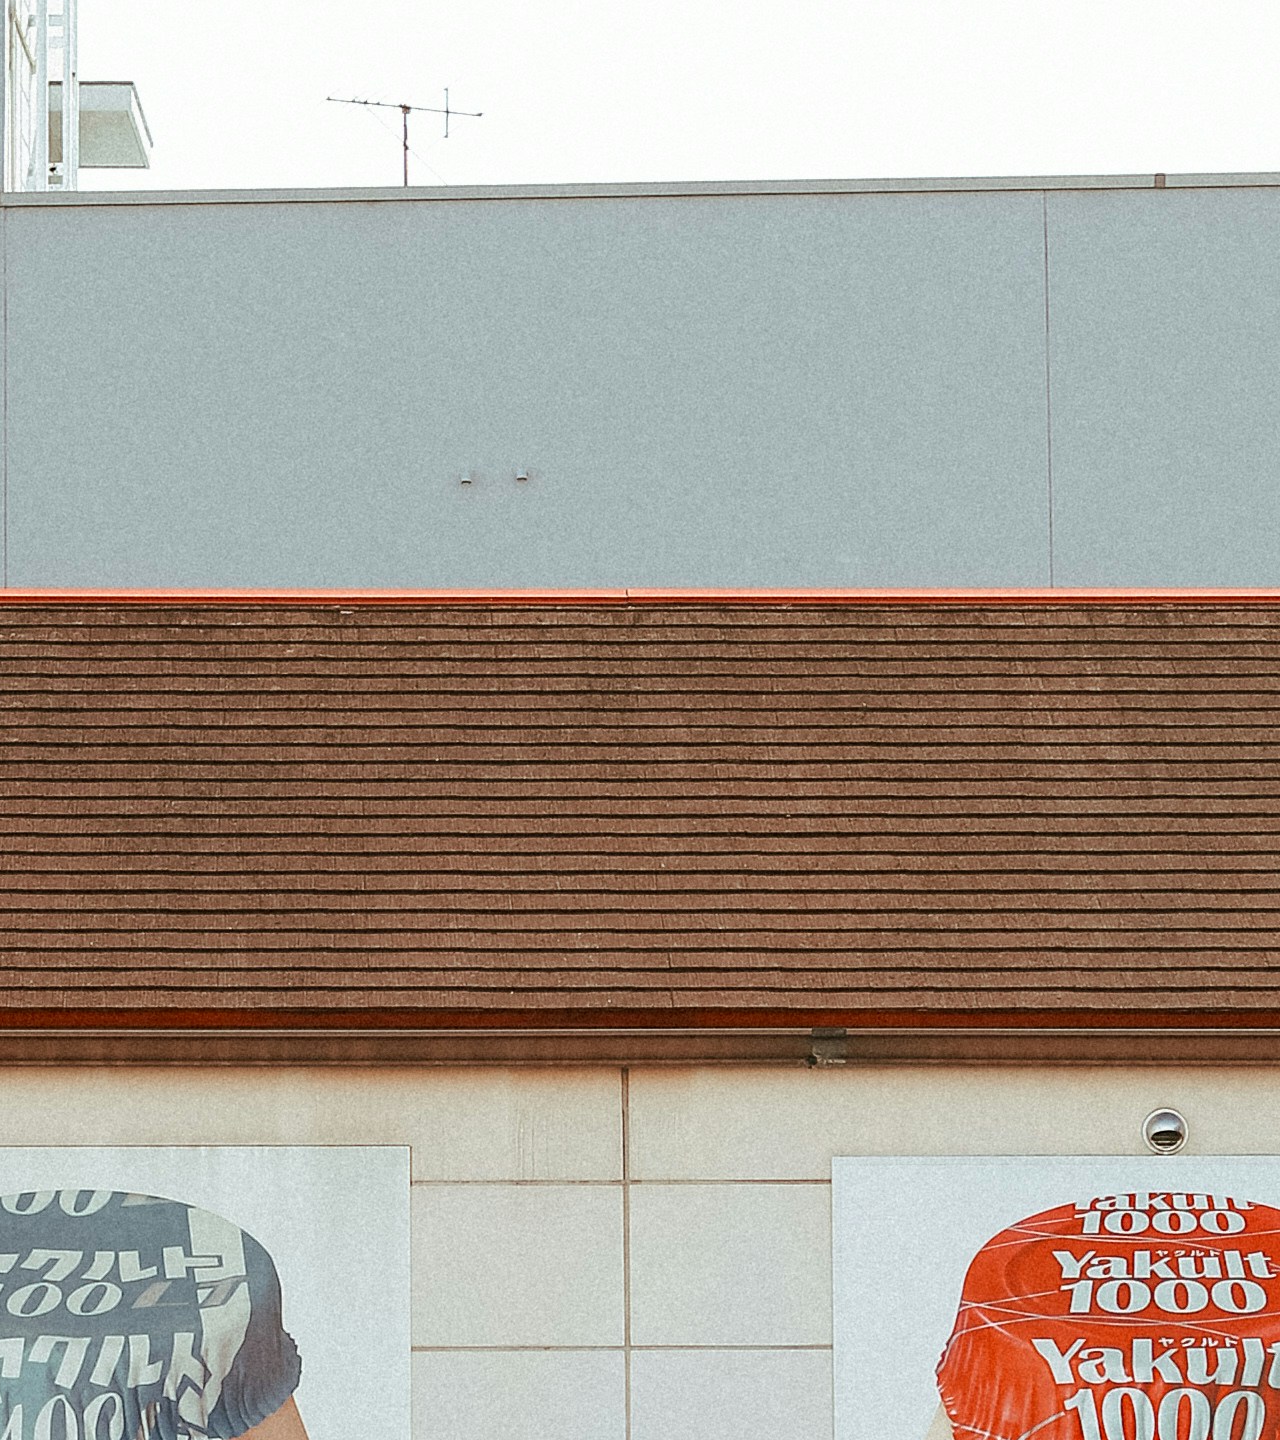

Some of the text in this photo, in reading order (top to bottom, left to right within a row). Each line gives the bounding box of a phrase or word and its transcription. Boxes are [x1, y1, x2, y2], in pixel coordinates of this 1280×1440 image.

[1074, 1210, 1247, 1235] 1000
[1051, 1250, 1277, 1279] Yakult
[1060, 1278, 1268, 1314] 1000
